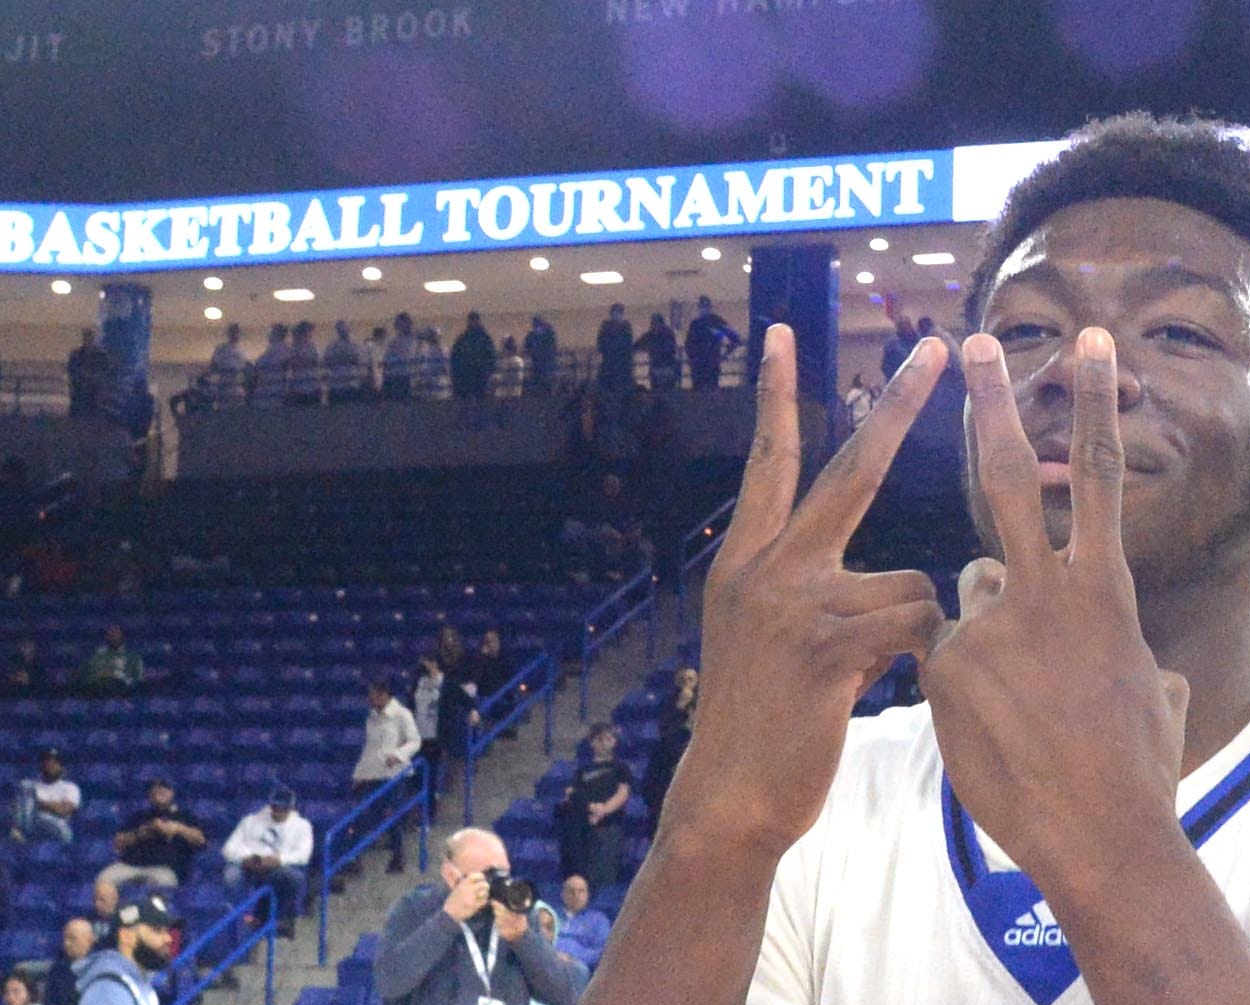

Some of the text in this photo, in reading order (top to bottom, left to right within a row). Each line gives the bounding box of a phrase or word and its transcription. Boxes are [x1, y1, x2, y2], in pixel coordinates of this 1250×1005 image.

[200, 7, 474, 57] STONY BROOK
[0, 159, 934, 265] BASKETBALL TOURNAMENT
